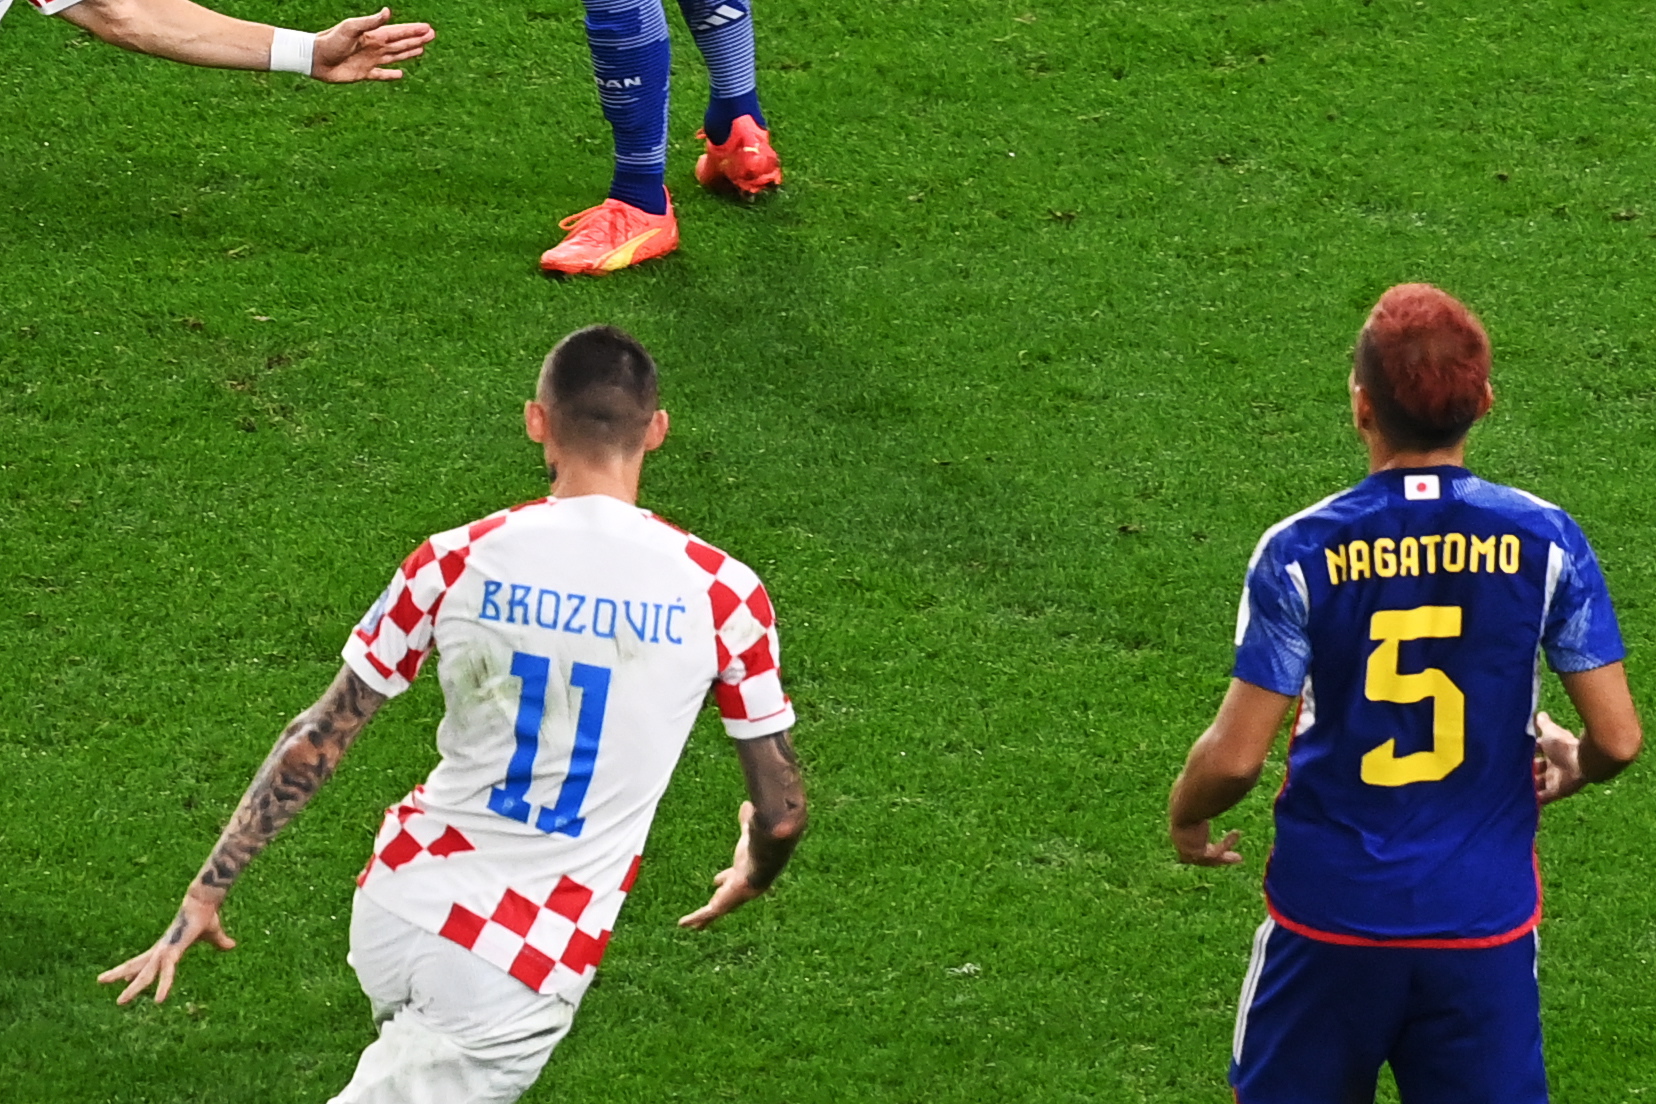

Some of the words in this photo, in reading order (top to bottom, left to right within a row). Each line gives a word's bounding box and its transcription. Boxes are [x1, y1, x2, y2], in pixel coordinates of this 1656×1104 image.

[479, 580, 686, 645] BROZOVIĆ
[1325, 533, 1520, 585] NAGATOMO
[488, 651, 612, 838] 11
[1360, 605, 1465, 787] 5
